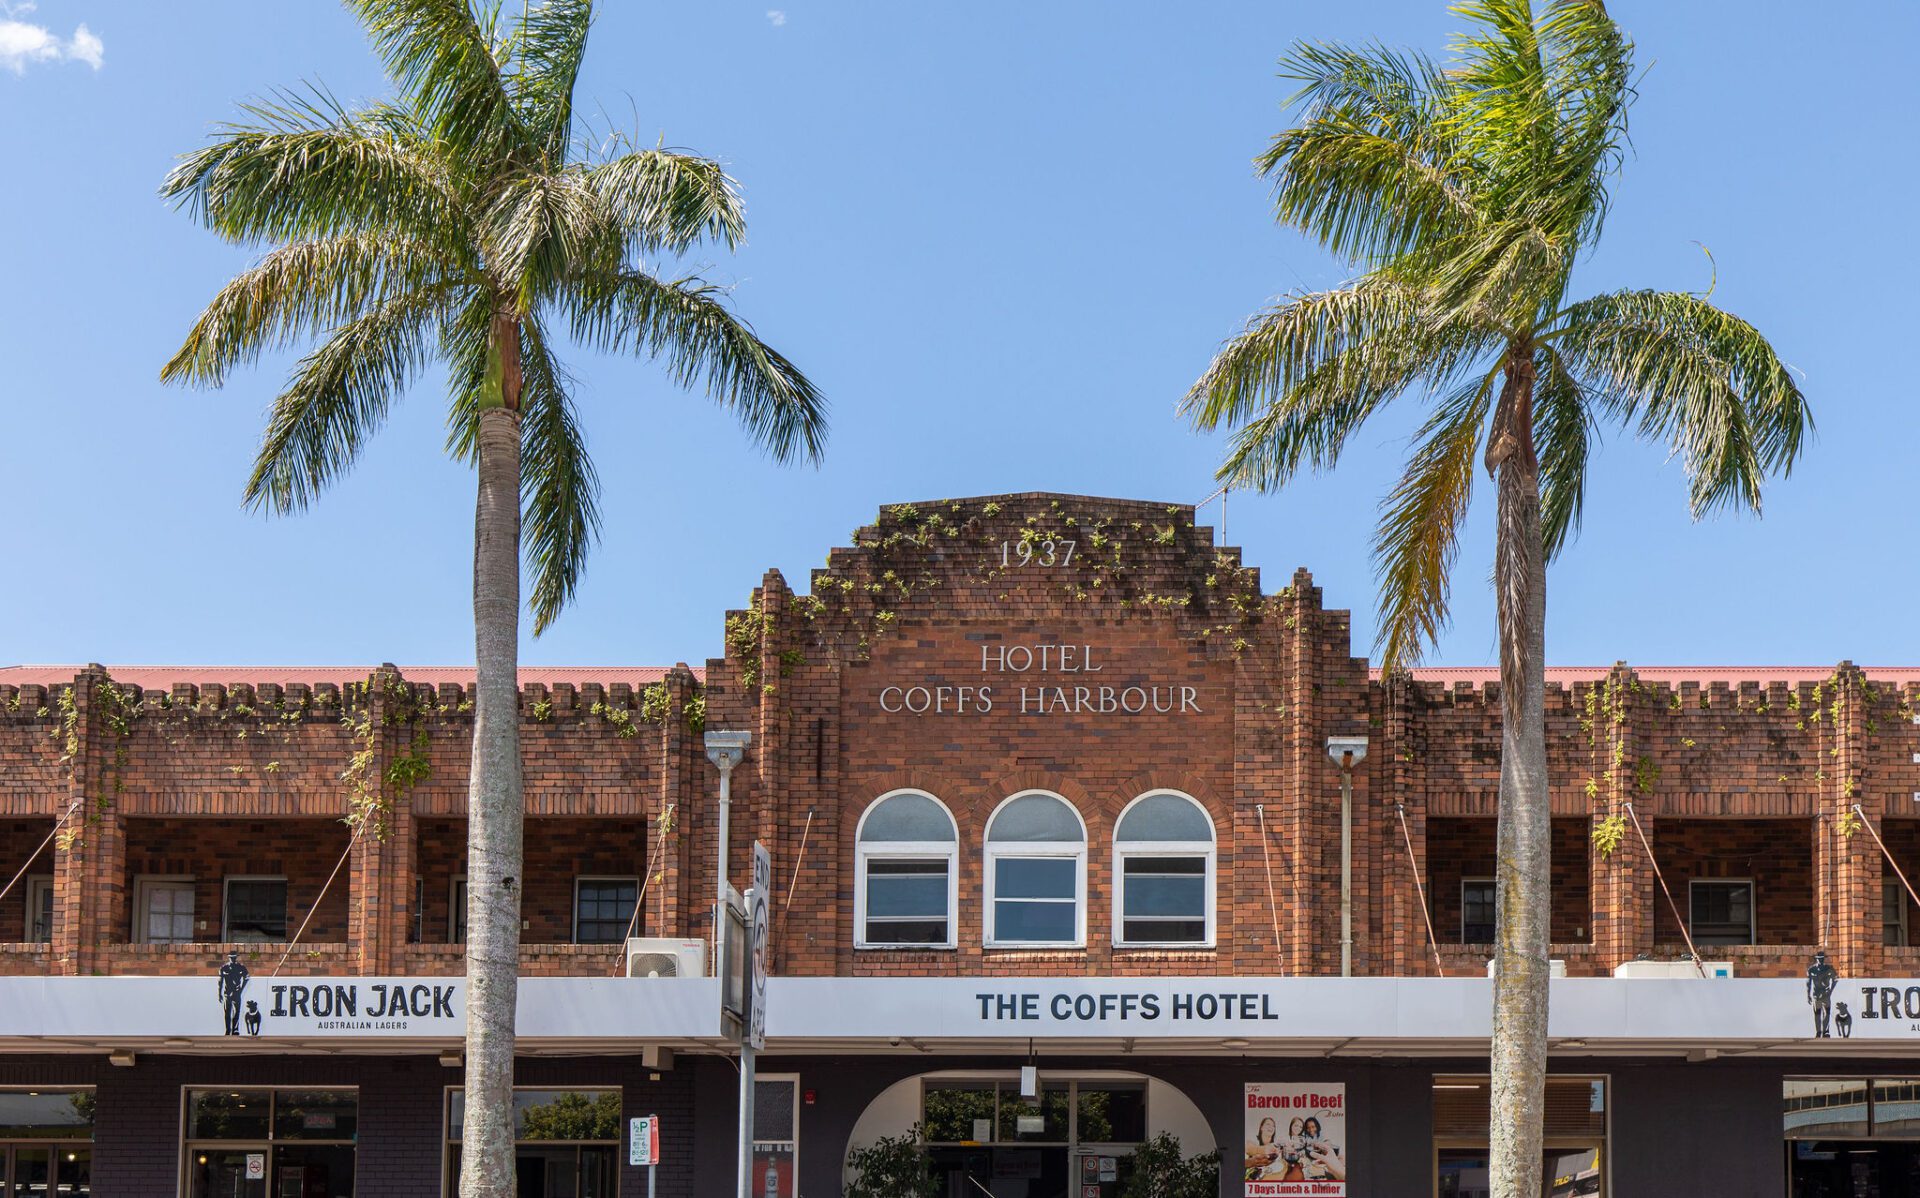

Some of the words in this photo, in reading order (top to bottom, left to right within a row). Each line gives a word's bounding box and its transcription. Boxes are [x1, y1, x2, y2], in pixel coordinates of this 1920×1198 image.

[1000, 540, 1076, 568] 1937
[981, 645, 1103, 672] HOTEL
[879, 686, 993, 713] COFFS
[1020, 686, 1203, 713] HARBOUR
[756, 854, 770, 891] END
[270, 984, 357, 1018] IRON
[366, 984, 456, 1018] JACK
[976, 994, 1040, 1020] THE
[1050, 994, 1161, 1021] COFFS
[1172, 994, 1279, 1020] HOTEL
[318, 1021, 371, 1030] AUSTRALIAN
[375, 1021, 408, 1030] LAGERS
[1247, 1094, 1290, 1108] Baron
[1293, 1094, 1307, 1108] of
[1310, 1094, 1343, 1108] Beef
[1248, 1184, 1254, 1194] 7
[1254, 1184, 1275, 1196] Days
[1277, 1184, 1302, 1194] Lunch
[1304, 1185, 1310, 1194] &
[1311, 1184, 1341, 1194] Dinner
